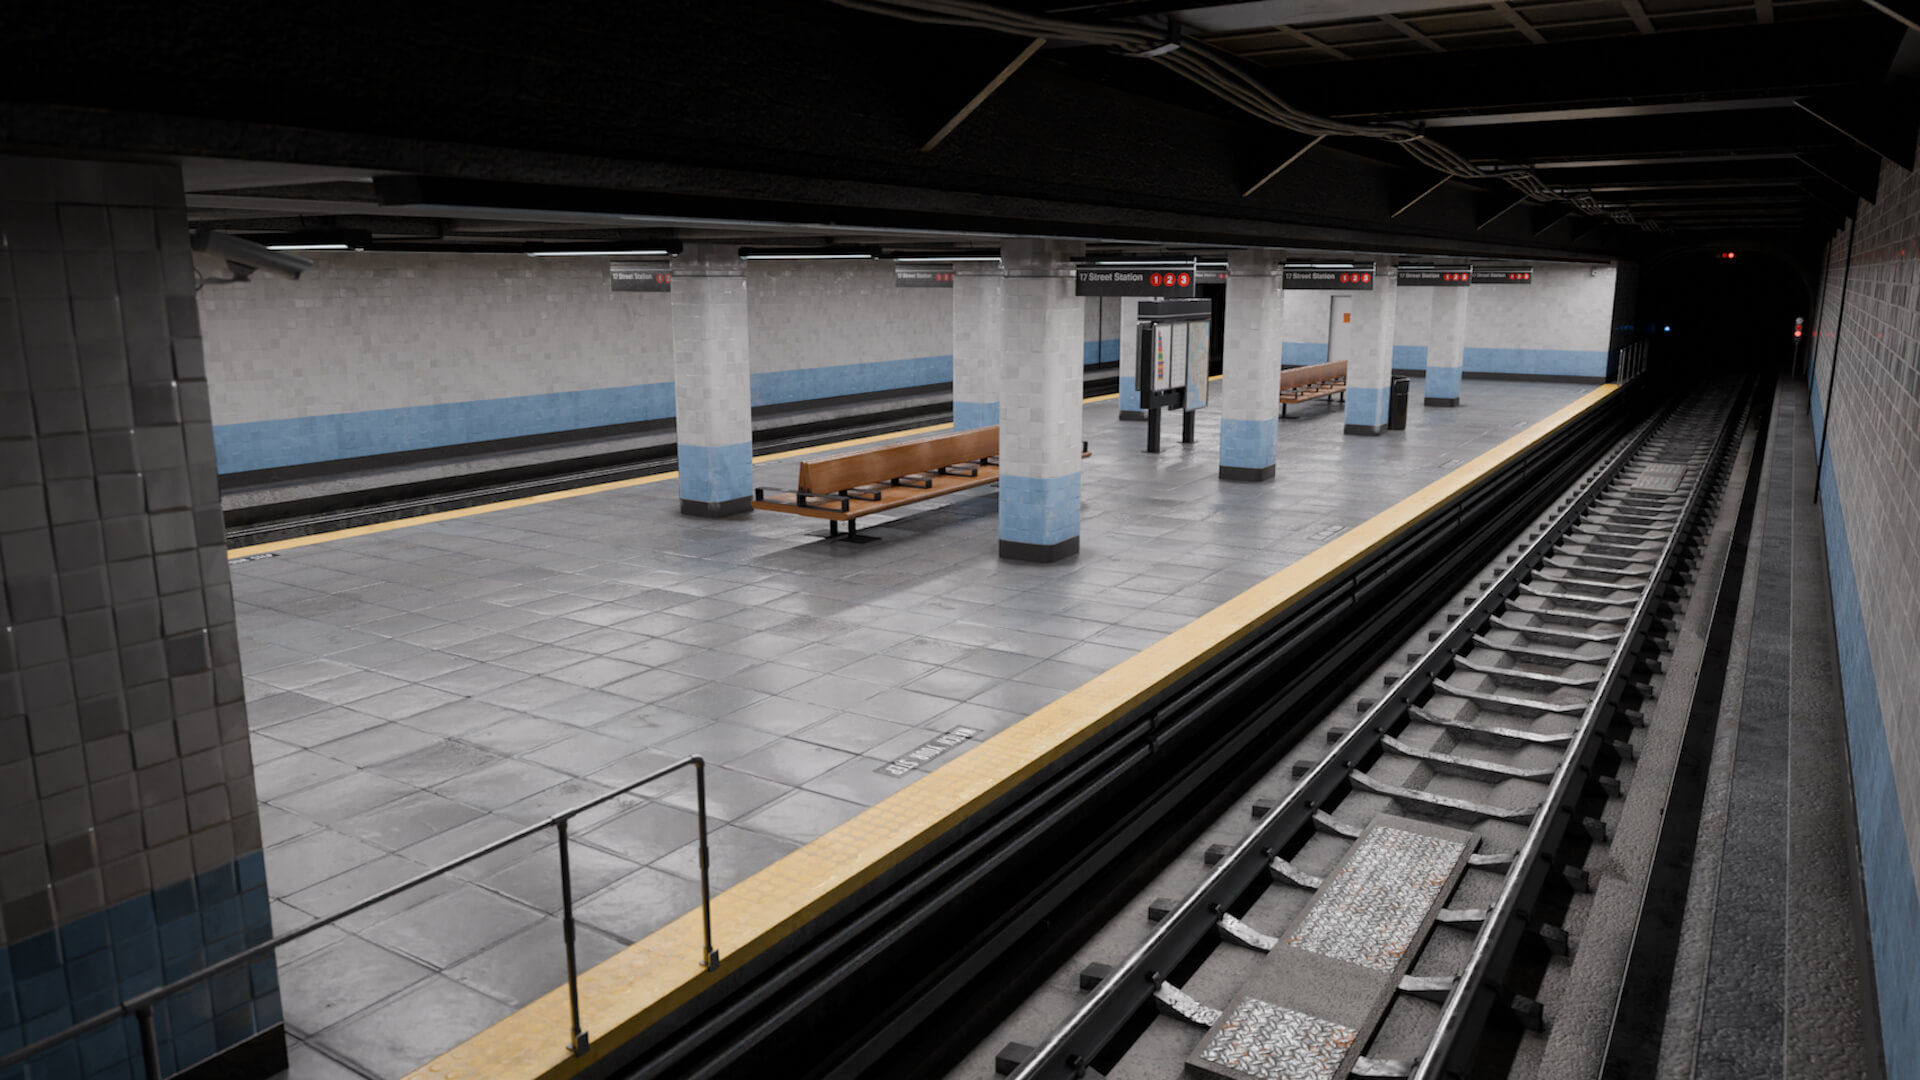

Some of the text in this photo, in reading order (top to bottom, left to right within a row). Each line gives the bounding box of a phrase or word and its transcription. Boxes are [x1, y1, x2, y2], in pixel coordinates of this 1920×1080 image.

[1080, 273, 1088, 281] 17
[1088, 272, 1113, 281] Street
[1114, 272, 1144, 281] Station
[1292, 272, 1312, 280] Street
[1312, 272, 1336, 280] Station
